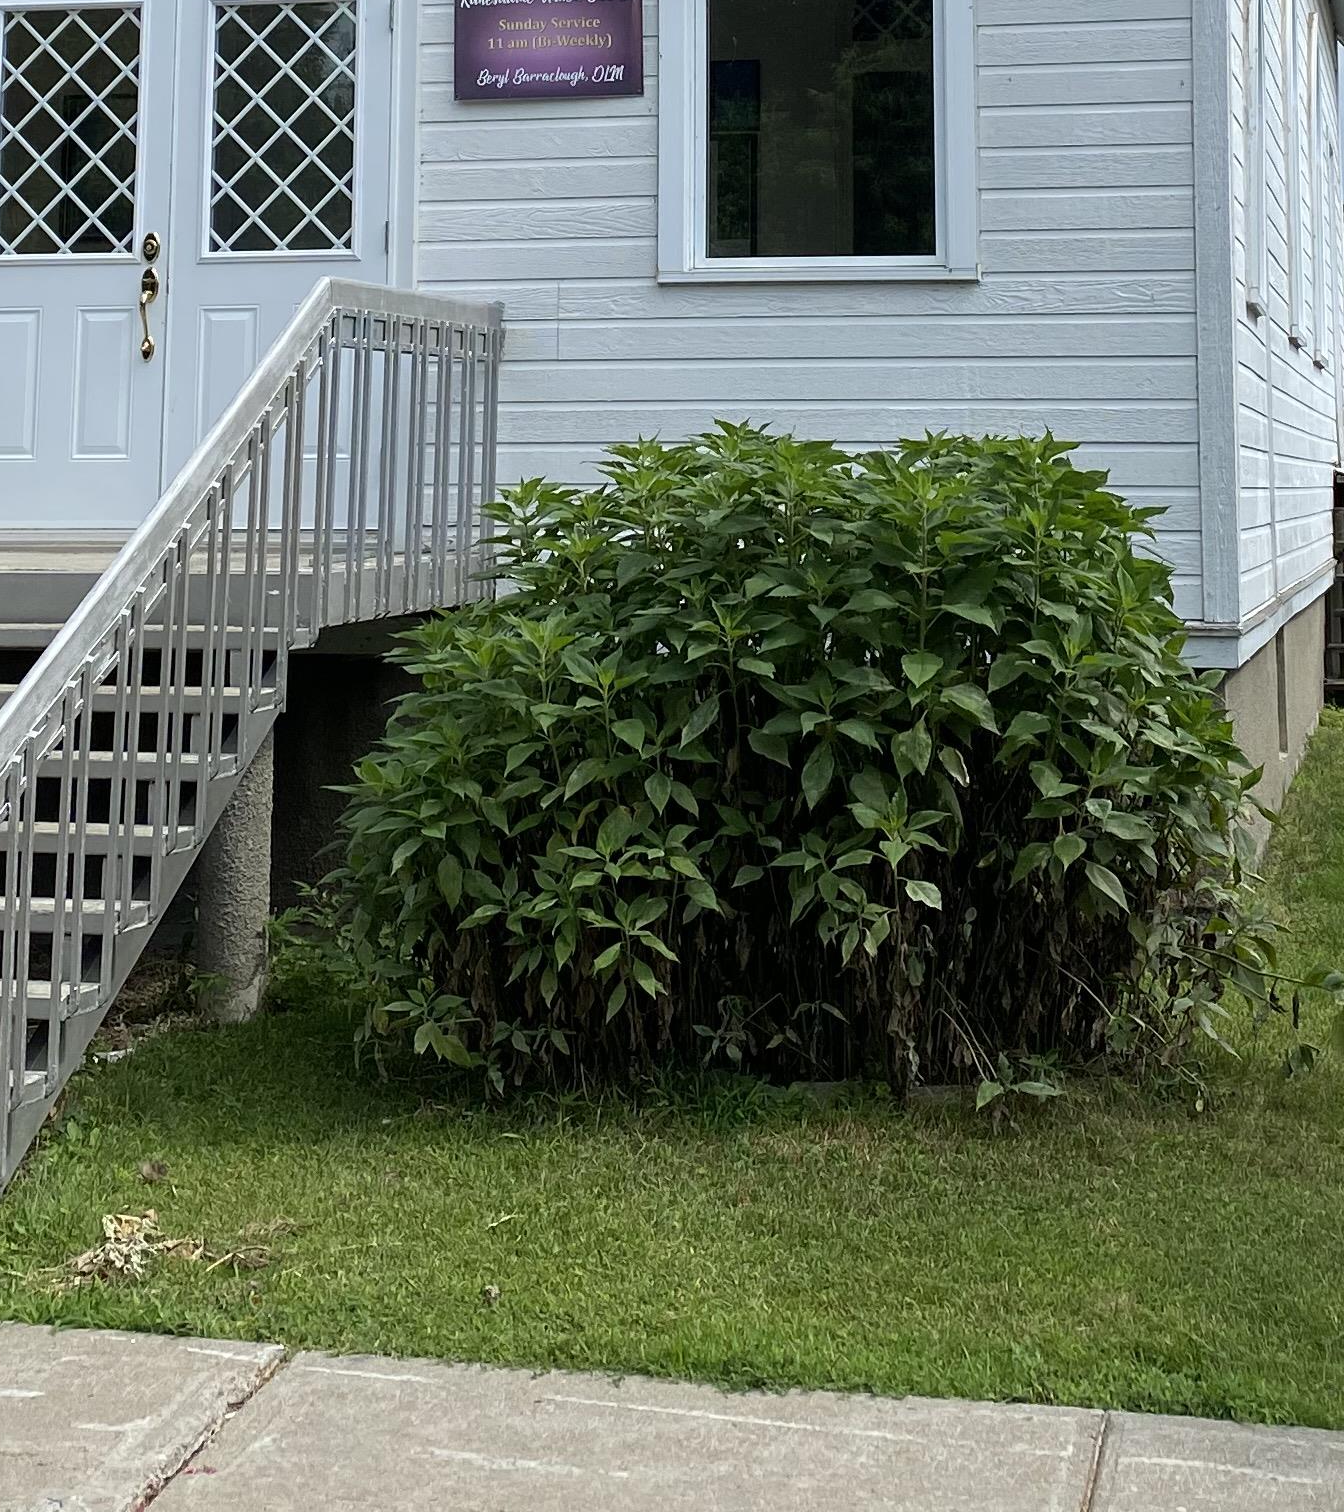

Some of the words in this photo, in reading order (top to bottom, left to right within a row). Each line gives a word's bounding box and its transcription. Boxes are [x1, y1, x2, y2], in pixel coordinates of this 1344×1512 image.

[499, 19, 547, 32] Sunday
[551, 17, 600, 28] Service
[488, 38, 503, 49] 11
[508, 39, 528, 48] am
[532, 34, 612, 49] (Bi-Weekly)
[477, 68, 509, 88] Beryl
